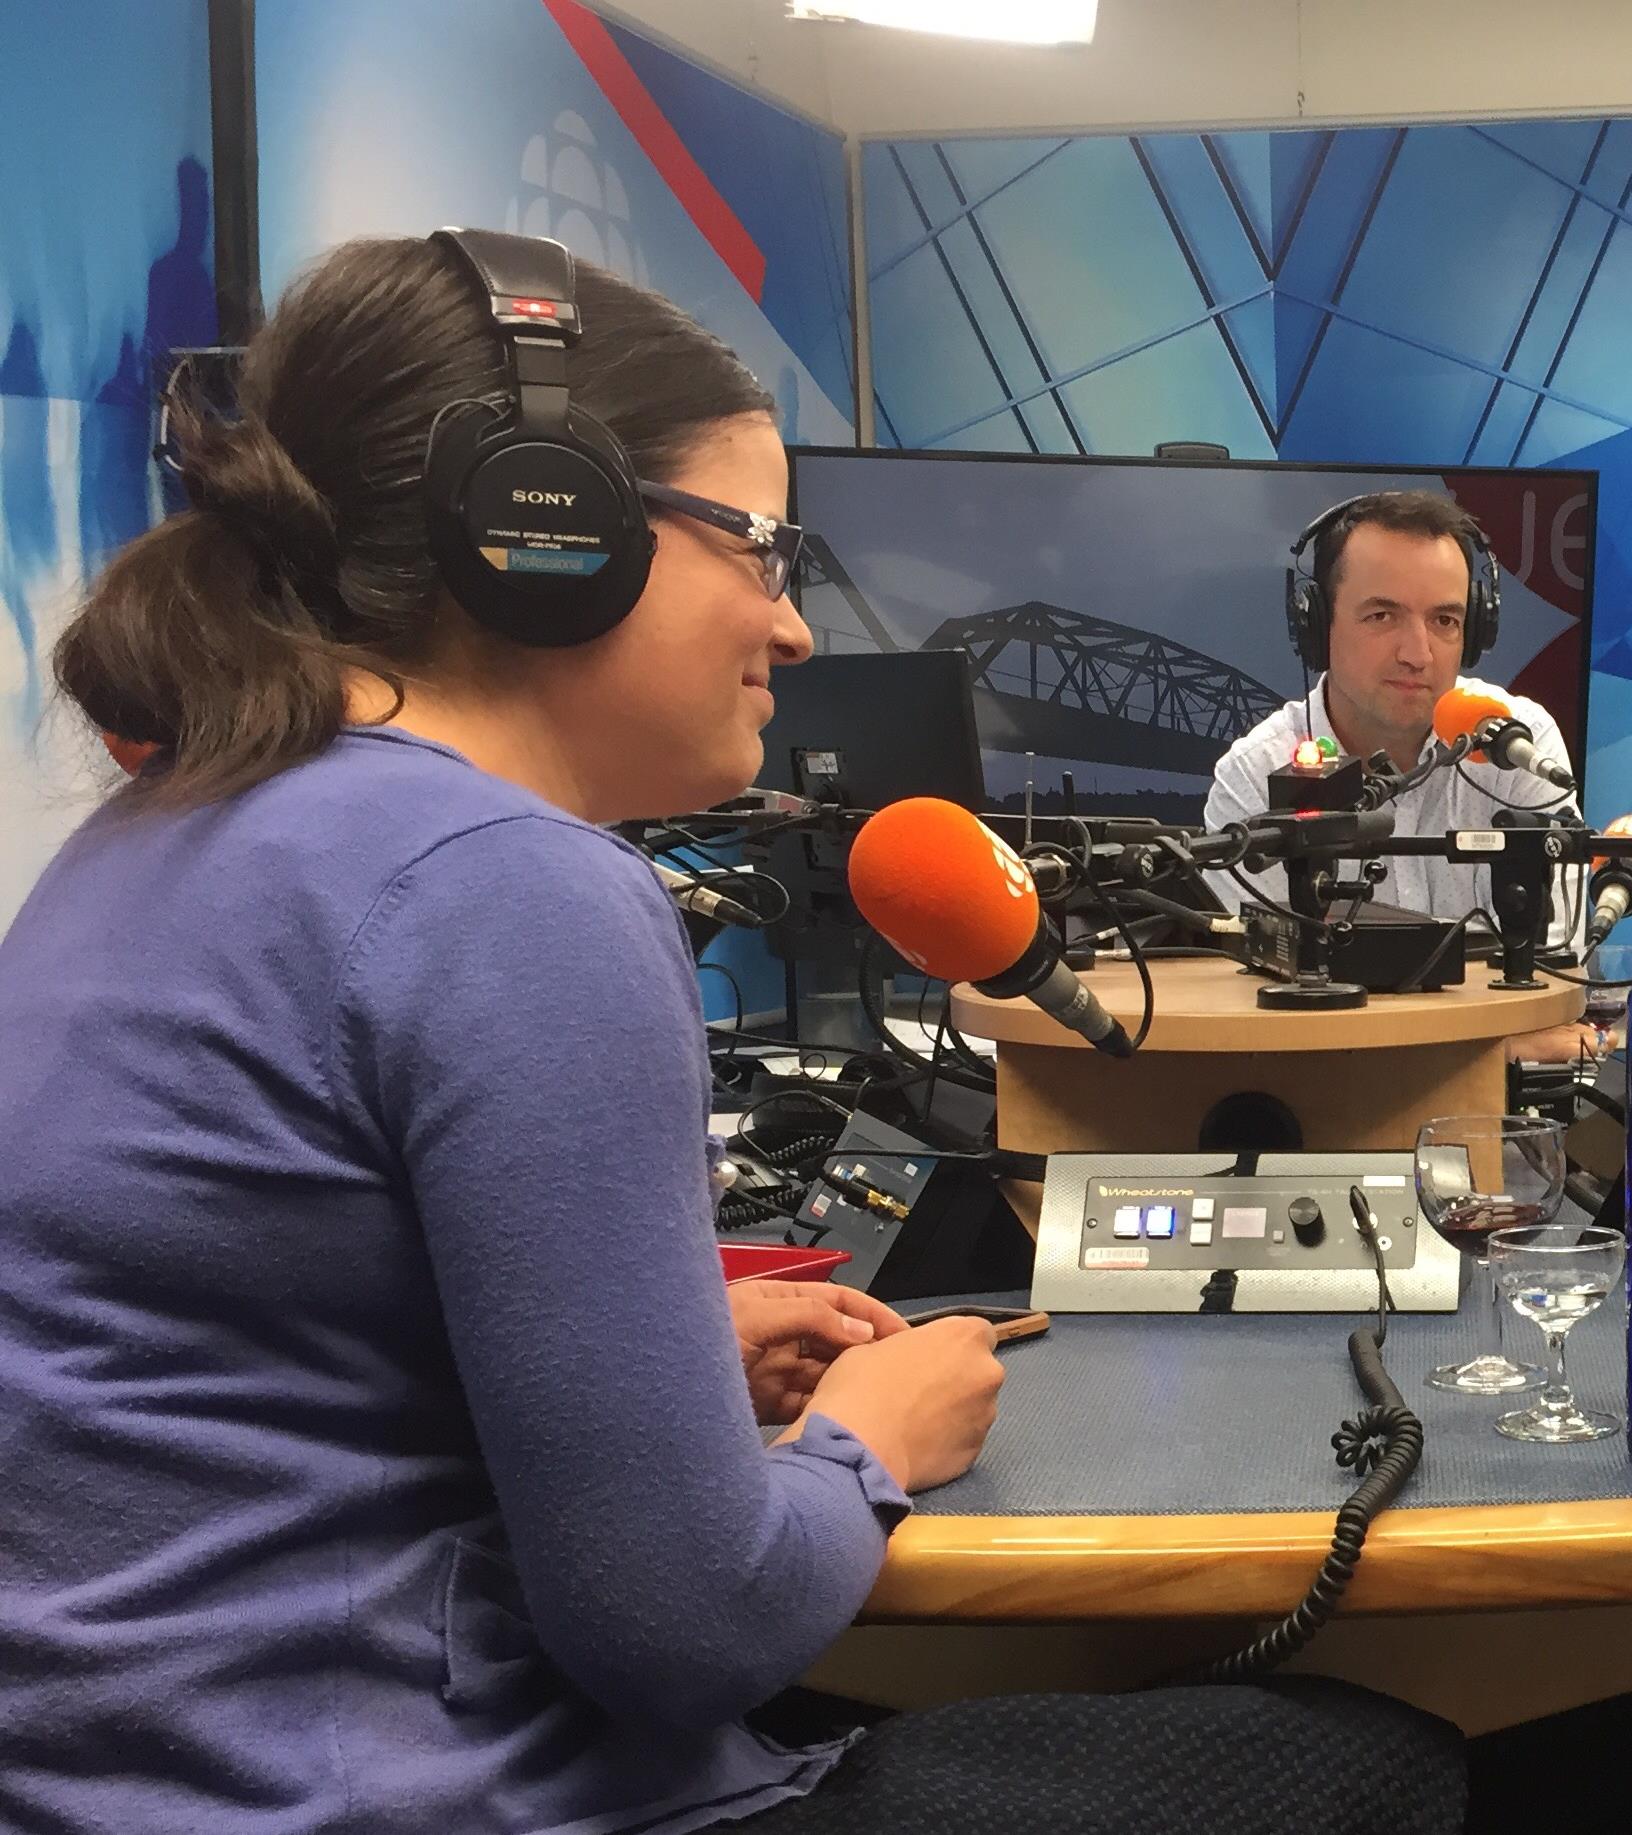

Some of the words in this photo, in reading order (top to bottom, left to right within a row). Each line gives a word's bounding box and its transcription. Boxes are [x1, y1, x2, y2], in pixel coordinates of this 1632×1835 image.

[512, 489, 577, 507] SONY
[511, 553, 584, 570] Professional
[1109, 1188, 1195, 1197] Wheatstone
